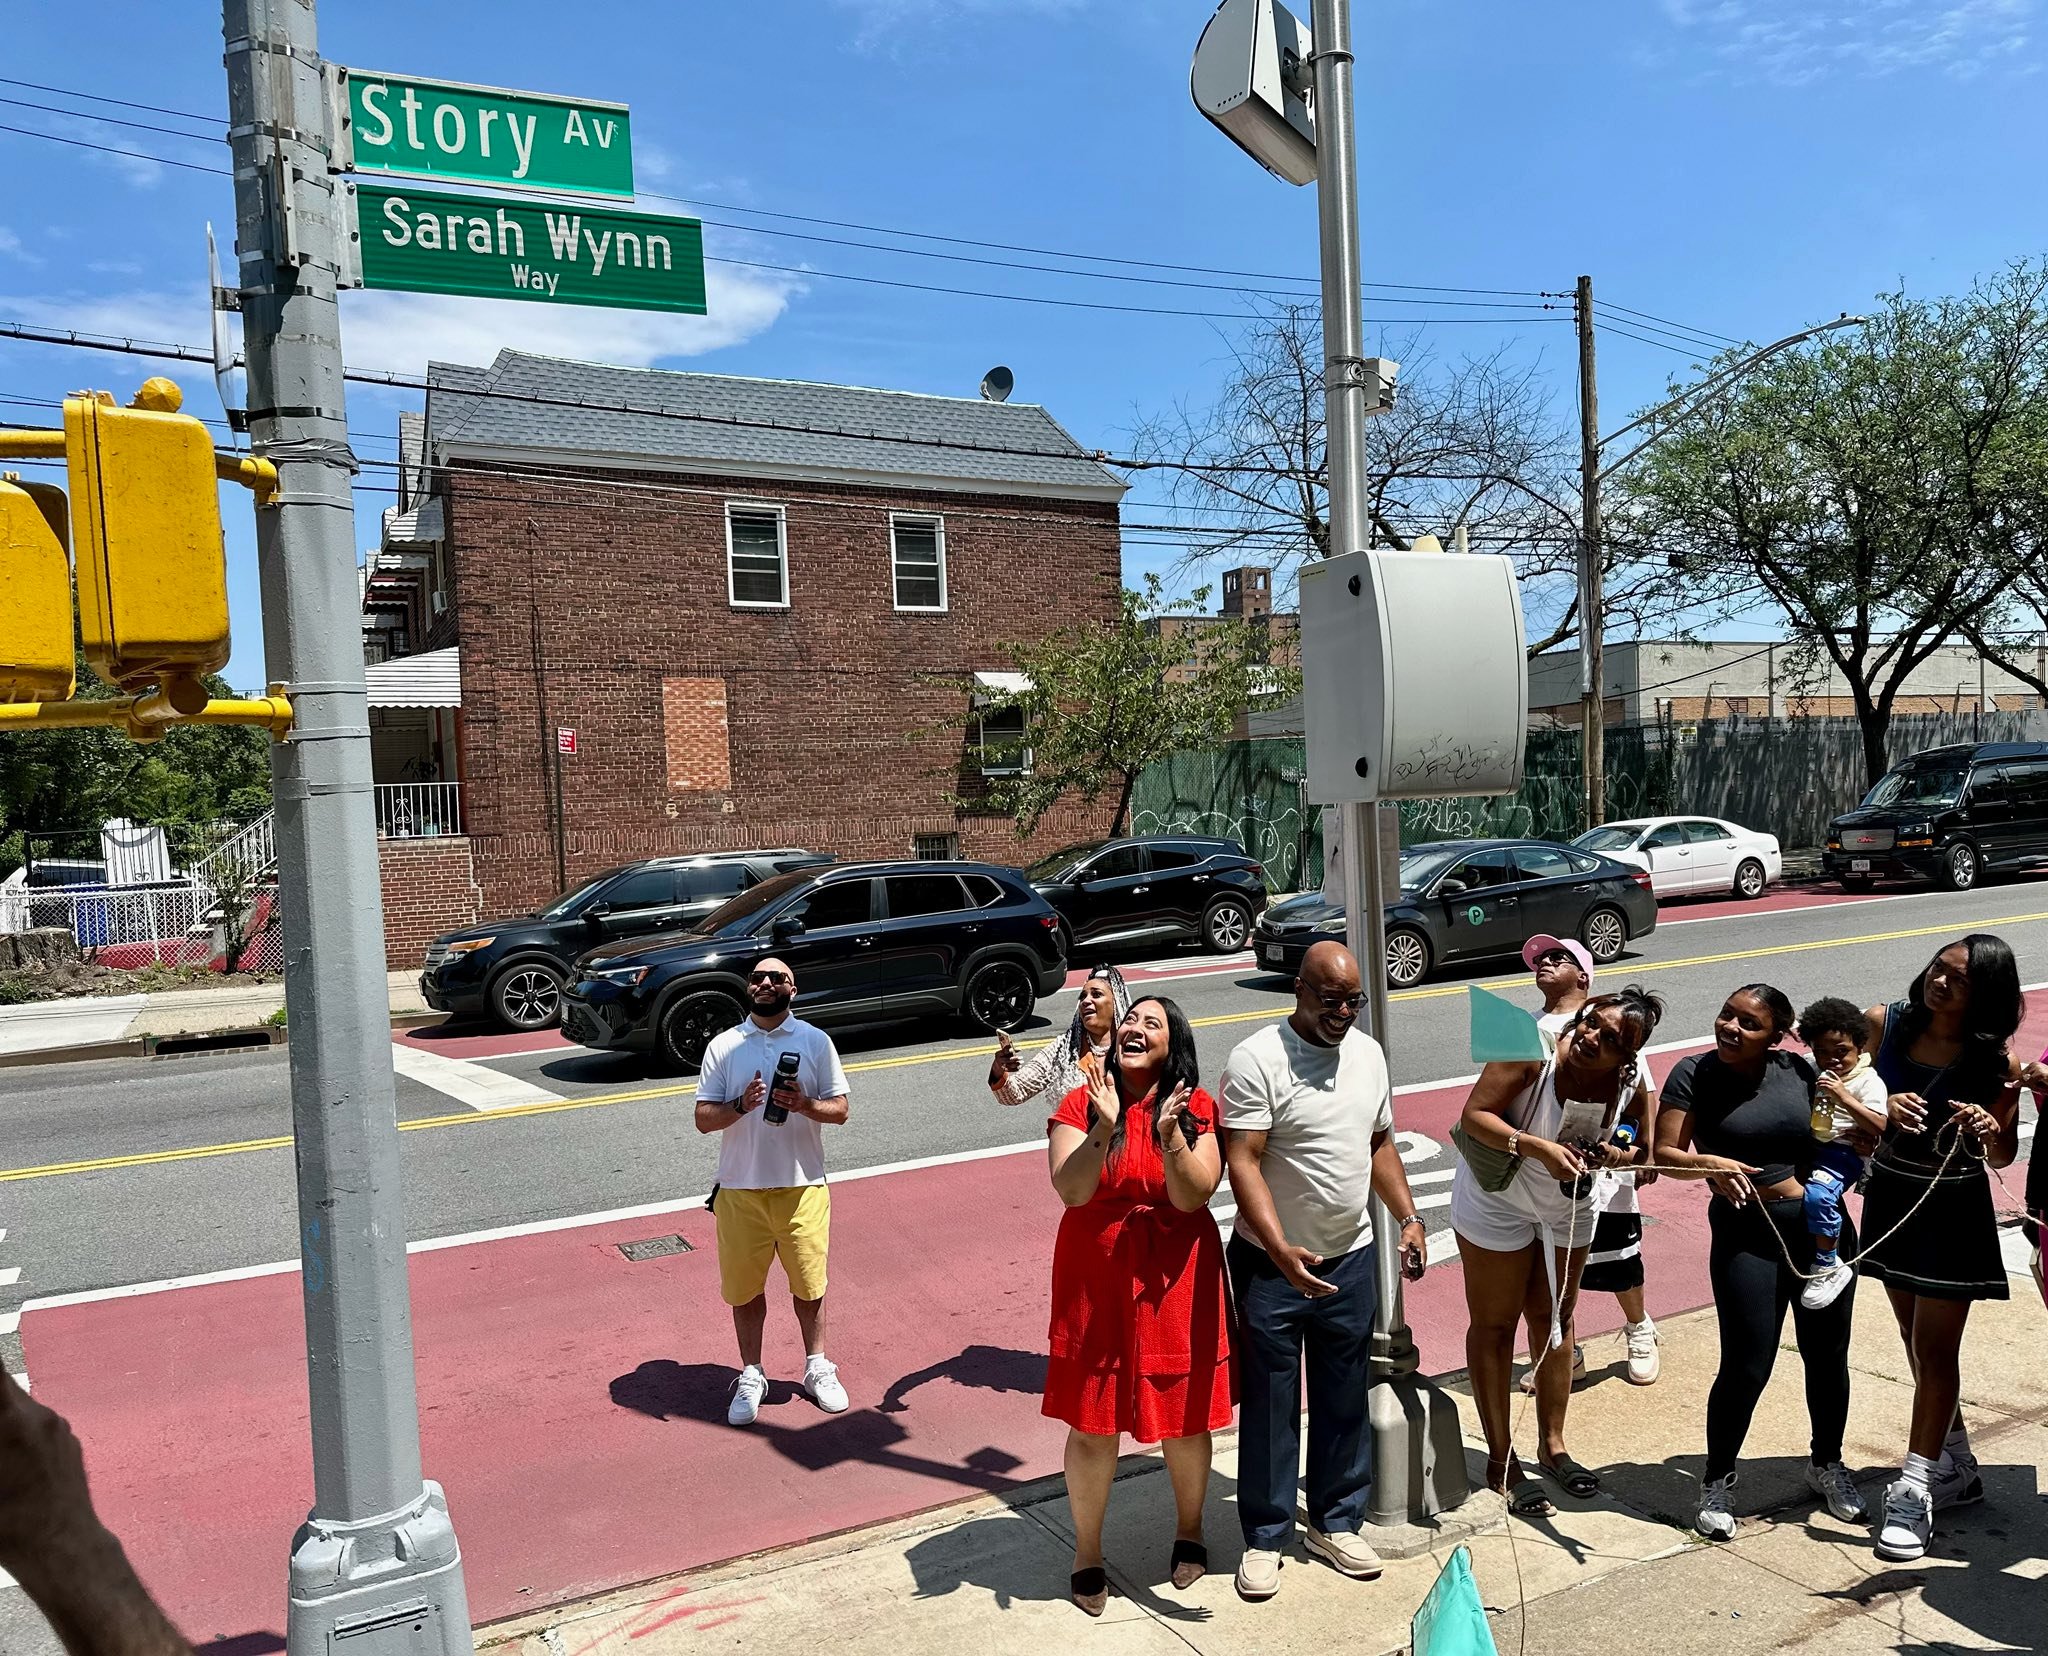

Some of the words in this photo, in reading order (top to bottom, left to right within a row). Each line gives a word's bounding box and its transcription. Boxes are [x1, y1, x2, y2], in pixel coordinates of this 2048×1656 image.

[361, 84, 536, 178] Story
[564, 110, 613, 149] Av
[383, 197, 524, 257] Sarah
[545, 213, 672, 276] Wynn
[511, 264, 560, 297] Way
[1472, 909, 1481, 923] P
